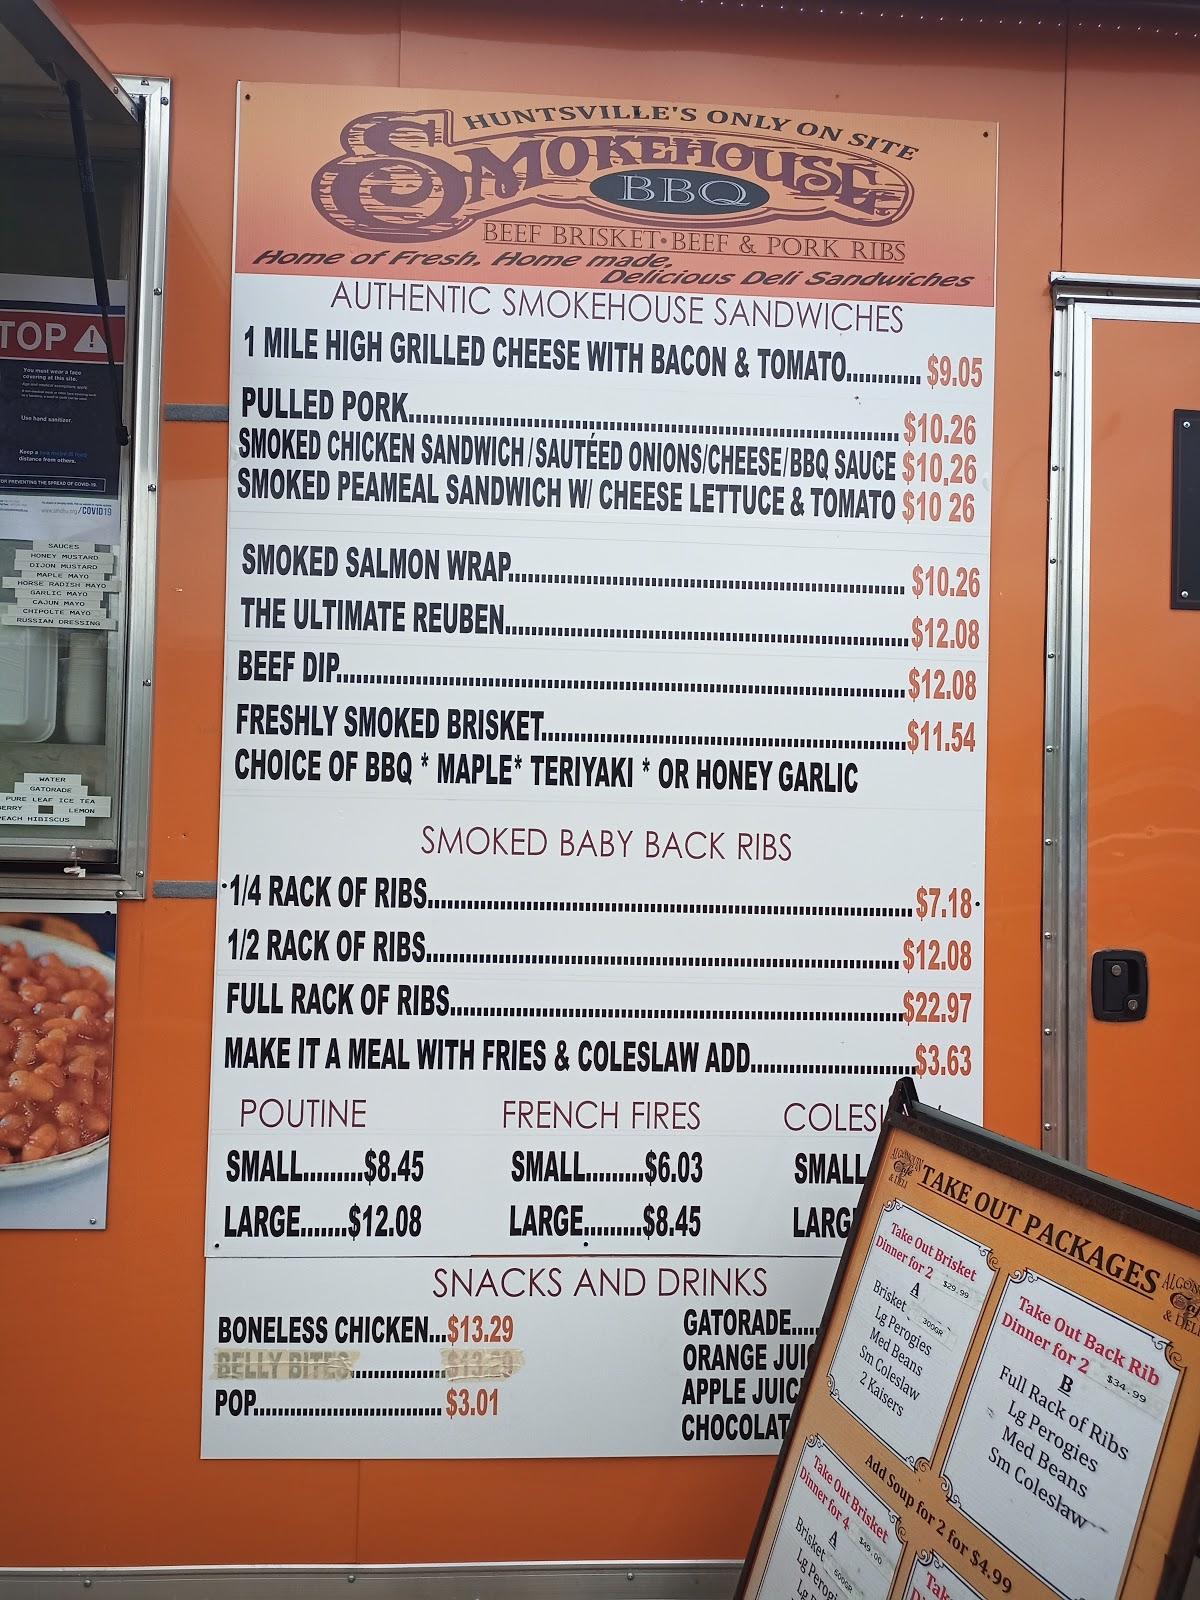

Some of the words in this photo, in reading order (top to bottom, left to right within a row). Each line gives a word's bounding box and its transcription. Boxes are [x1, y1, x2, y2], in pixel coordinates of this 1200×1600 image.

[463, 104, 697, 130] HUNTSVILLE'S
[706, 110, 791, 132] ONLY
[796, 121, 843, 141] ON
[847, 132, 920, 161] SITE
[312, 109, 910, 243] SMOKEHOUSE
[619, 174, 750, 207] BBQ
[252, 249, 345, 266] Home
[350, 250, 388, 266] of
[388, 250, 481, 267] Fresh,
[491, 251, 583, 268] Home
[601, 269, 736, 286] Delicious
[740, 270, 799, 287] Deli
[804, 270, 975, 288] Sandwiches
[331, 281, 490, 315] AUTHENTIC
[502, 287, 703, 325] SMOKEHOUSE
[714, 297, 903, 334] SANDWICHES
[0, 320, 67, 351] TOP
[244, 326, 254, 357] 1
[264, 327, 318, 360] MILE
[326, 330, 382, 362] HIGH
[390, 332, 485, 367] GRILLED
[493, 337, 580, 371] CHEESE
[587, 341, 643, 374] WITH
[651, 343, 727, 378] BACON
[734, 347, 749, 378] &
[758, 348, 847, 382] TOMATO
[926, 353, 983, 389] $9.05
[242, 387, 333, 420] PULLED
[342, 390, 408, 423] PORK
[903, 410, 977, 446] $10.26
[242, 544, 339, 577] SMOKED
[345, 546, 440, 580] SALMON
[447, 550, 512, 582] WRAP
[911, 564, 980, 600] $10.26
[238, 650, 295, 681] BEEF
[303, 651, 340, 683] DIP
[908, 667, 977, 703] $12.08
[421, 825, 548, 857] SMOKED
[560, 829, 634, 858] BABY
[645, 831, 726, 860] BACK
[738, 833, 792, 862] RIBS
[230, 874, 261, 906] 1/4
[269, 875, 331, 908] RACK
[338, 876, 367, 908] OF
[375, 877, 427, 909] RIBS
[916, 885, 972, 922] $7.18
[240, 1098, 367, 1128] POUTINE
[502, 1100, 619, 1130] FRENCH
[632, 1102, 701, 1130] FIRES
[784, 1102, 884, 1132] COLES
[794, 1152, 867, 1185] SMALL
[224, 1205, 301, 1237] LARGE
[348, 1203, 422, 1241] $12.08
[920, 1164, 972, 1205] TAKE
[974, 1191, 1022, 1228] OUT
[1022, 1212, 1161, 1295] PACKAGES
[875, 1235, 908, 1263] Dinner
[908, 1255, 926, 1272] for
[924, 1267, 935, 1280] 2
[891, 1222, 913, 1245] Take
[914, 1237, 934, 1257] Out
[934, 1248, 977, 1282] Brisket
[433, 1267, 563, 1298] SNACKS
[573, 1268, 646, 1297] AND
[658, 1268, 767, 1298] DRINKS
[872, 1279, 907, 1313] Brisket
[943, 1280, 969, 1299] $29.99
[218, 1316, 328, 1344] BONELESS
[335, 1316, 429, 1344] CHICKEN
[447, 1313, 513, 1346] $13.29
[683, 1308, 792, 1336] GATORADE
[874, 1305, 888, 1327] Lg
[887, 1317, 932, 1356] Perogies
[1001, 1312, 1051, 1350] Dinner
[1052, 1341, 1077, 1367] for
[1077, 1357, 1090, 1375] 2
[1018, 1296, 1051, 1326] Take
[1054, 1317, 1081, 1343] Out
[1083, 1333, 1125, 1367] Back
[1127, 1355, 1160, 1387] Rib
[859, 1345, 874, 1366] Sm
[874, 1357, 920, 1401] Coleslaw
[869, 1327, 891, 1353] Med
[890, 1346, 923, 1377] Beans
[215, 1389, 256, 1416] POP
[446, 1387, 498, 1420] $3.01
[682, 1378, 746, 1405] APPLE
[752, 1377, 804, 1405] JUIC
[859, 1371, 869, 1386] 2
[867, 1377, 904, 1417] Kaisers
[1106, 1374, 1147, 1404] $34.99
[682, 1413, 793, 1441] CHOCOLAT
[998, 1365, 1026, 1395] Full
[1028, 1383, 1066, 1419] Rack
[1068, 1411, 1089, 1433] of
[1088, 1421, 1130, 1461] Ribs
[800, 1466, 828, 1507] Dinner
[827, 1499, 844, 1521] for
[842, 1516, 850, 1531] 4
[813, 1455, 834, 1485] Take
[834, 1478, 851, 1505] Out
[850, 1495, 889, 1544] Brisket
[864, 1454, 886, 1481] Add
[886, 1473, 916, 1509] Soup
[916, 1500, 936, 1526] for
[935, 1519, 946, 1537] 2
[947, 1530, 969, 1556] for
[969, 1550, 1013, 1593] $4.99
